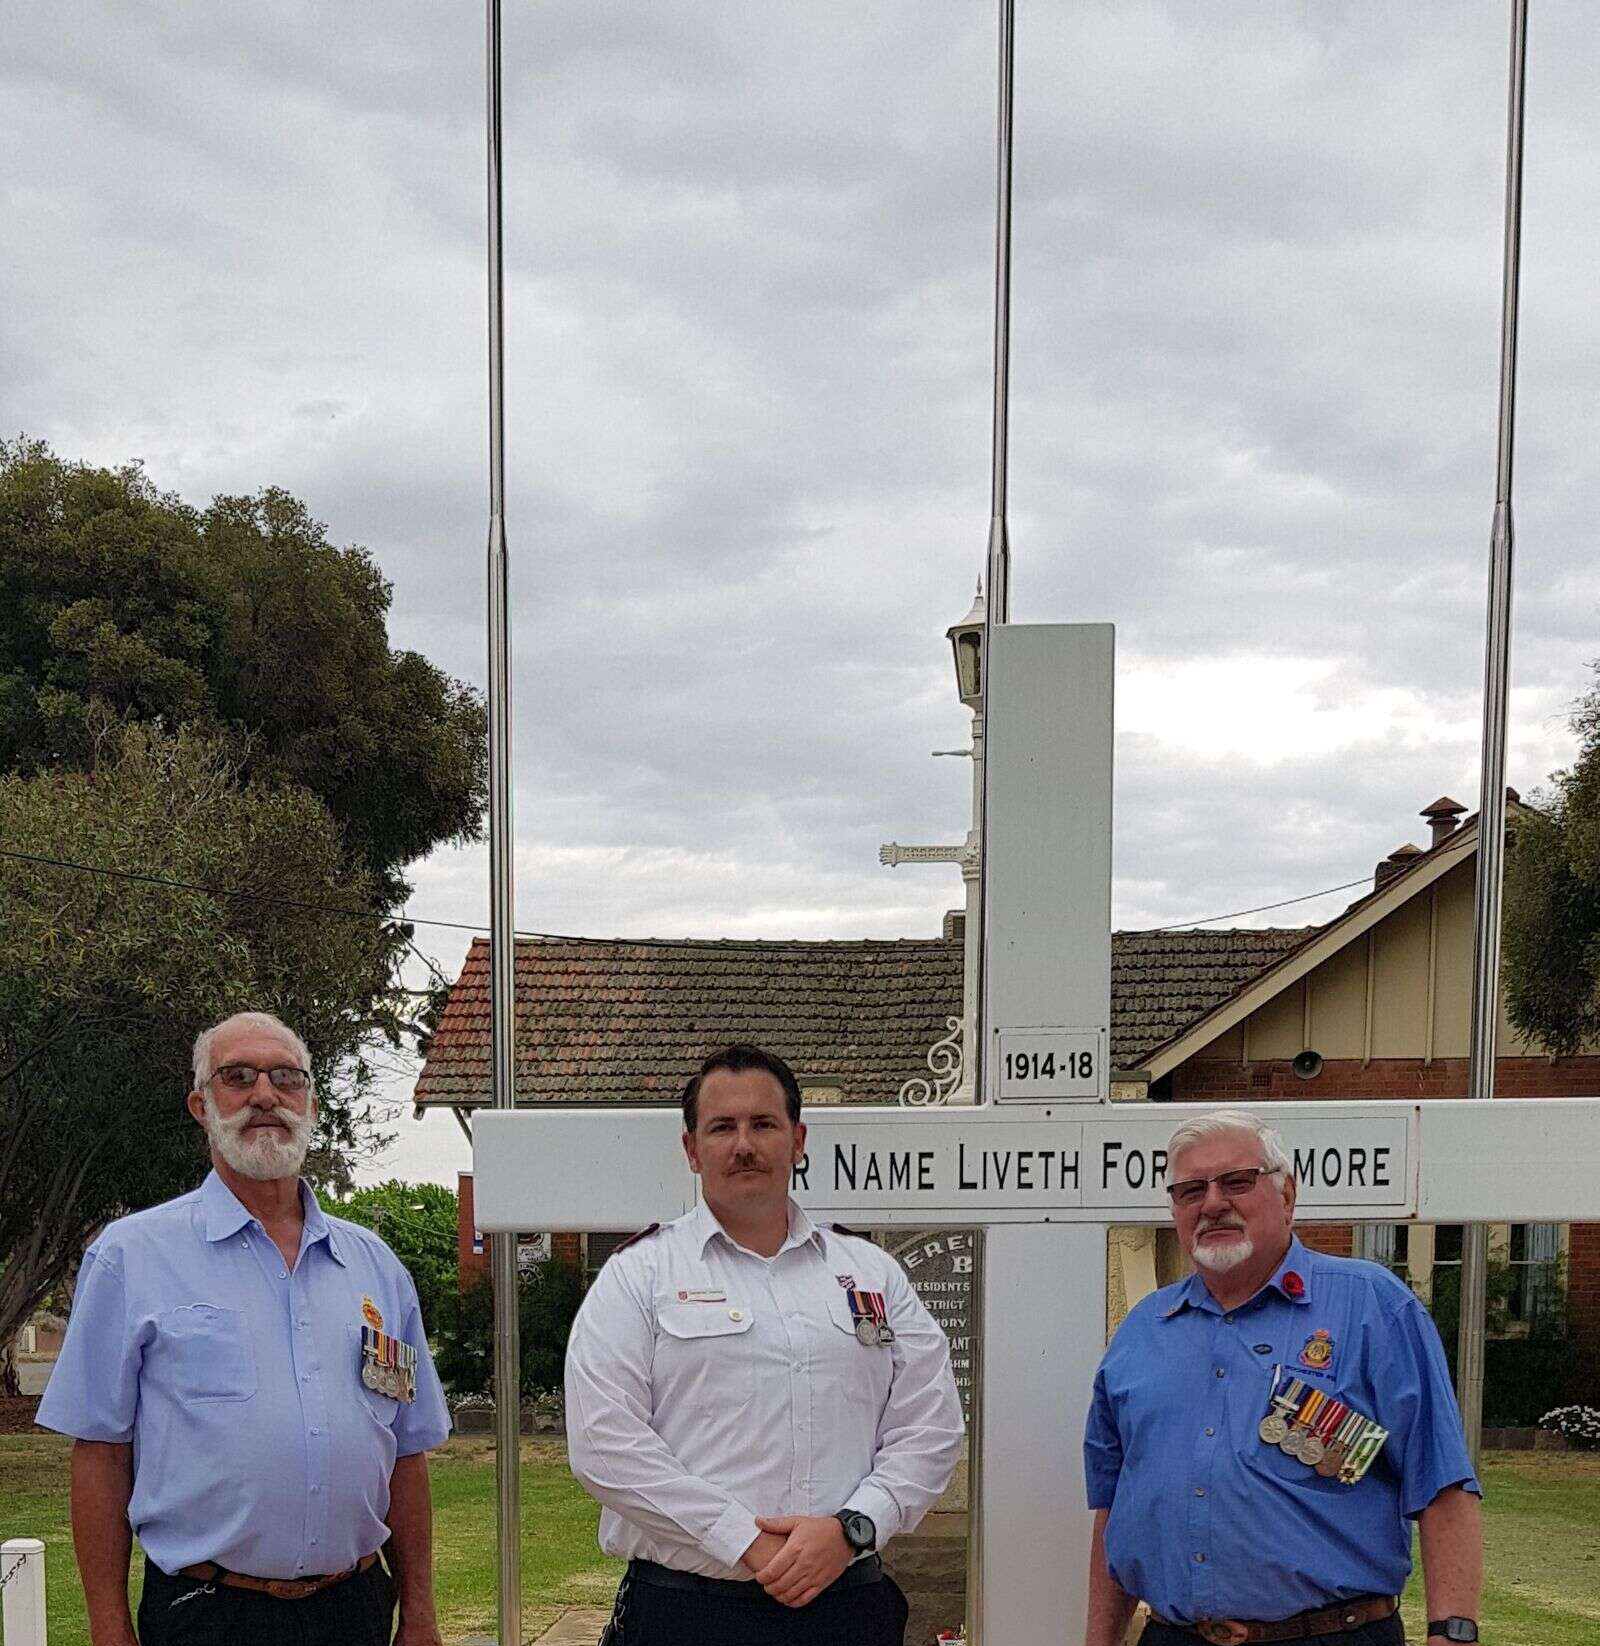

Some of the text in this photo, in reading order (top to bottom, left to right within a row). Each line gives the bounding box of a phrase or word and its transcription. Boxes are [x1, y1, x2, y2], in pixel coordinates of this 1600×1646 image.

[1006, 1052, 1093, 1079] 1914-18
[834, 1143, 935, 1190] NAME
[958, 1143, 1079, 1189] LIVETH
[1292, 1147, 1390, 1187] MORE
[921, 1300, 965, 1310] STRICT
